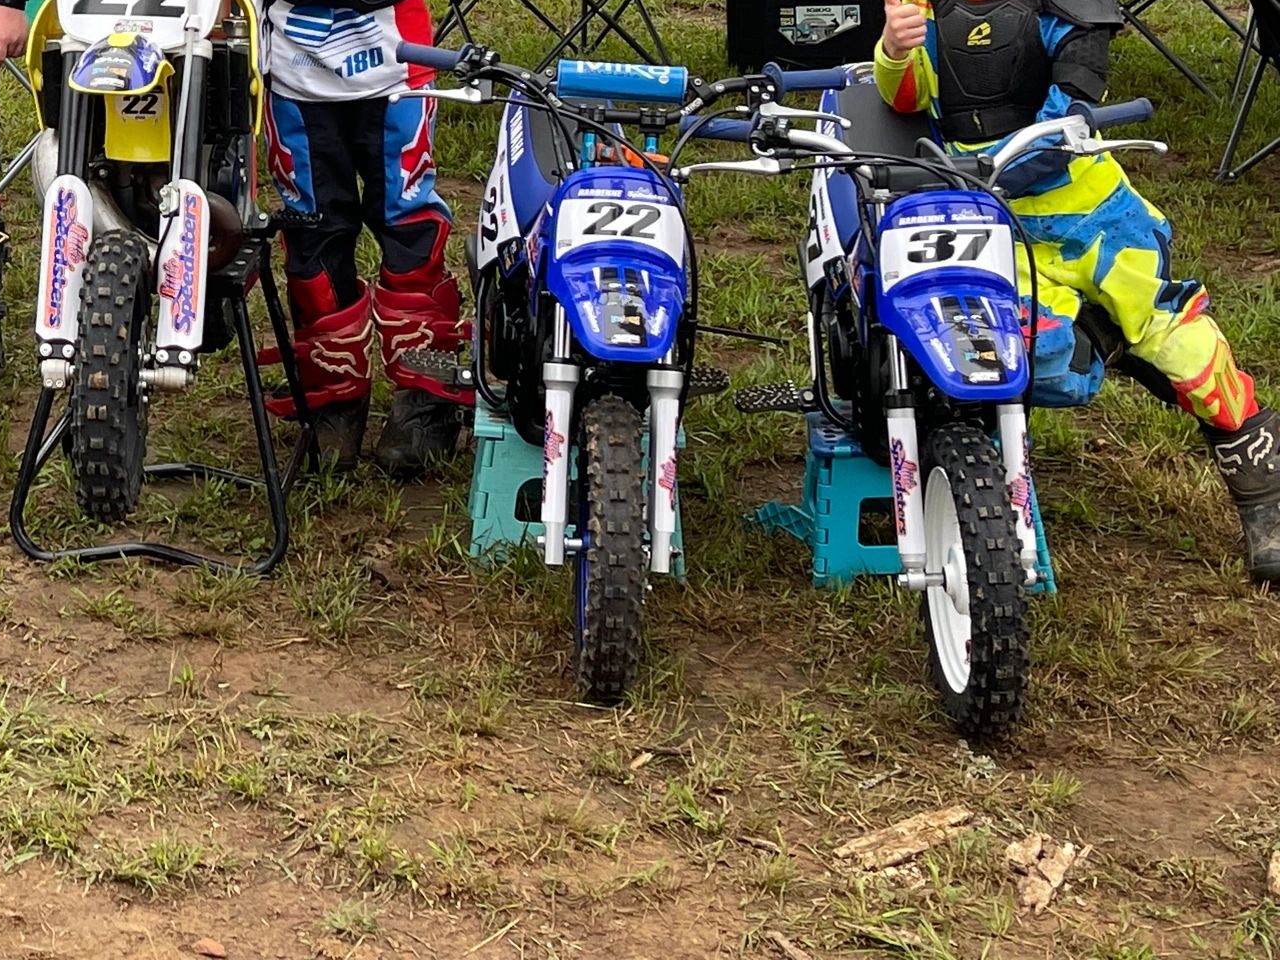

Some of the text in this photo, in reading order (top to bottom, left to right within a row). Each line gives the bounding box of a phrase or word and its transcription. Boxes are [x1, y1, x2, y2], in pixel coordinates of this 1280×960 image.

[342, 46, 384, 77] 180
[121, 93, 159, 115] 22
[582, 202, 661, 239] 22
[48, 187, 78, 329] Speedsters
[174, 194, 198, 333] Speedsters
[907, 228, 993, 263] 37
[891, 437, 907, 535] Speedsters
